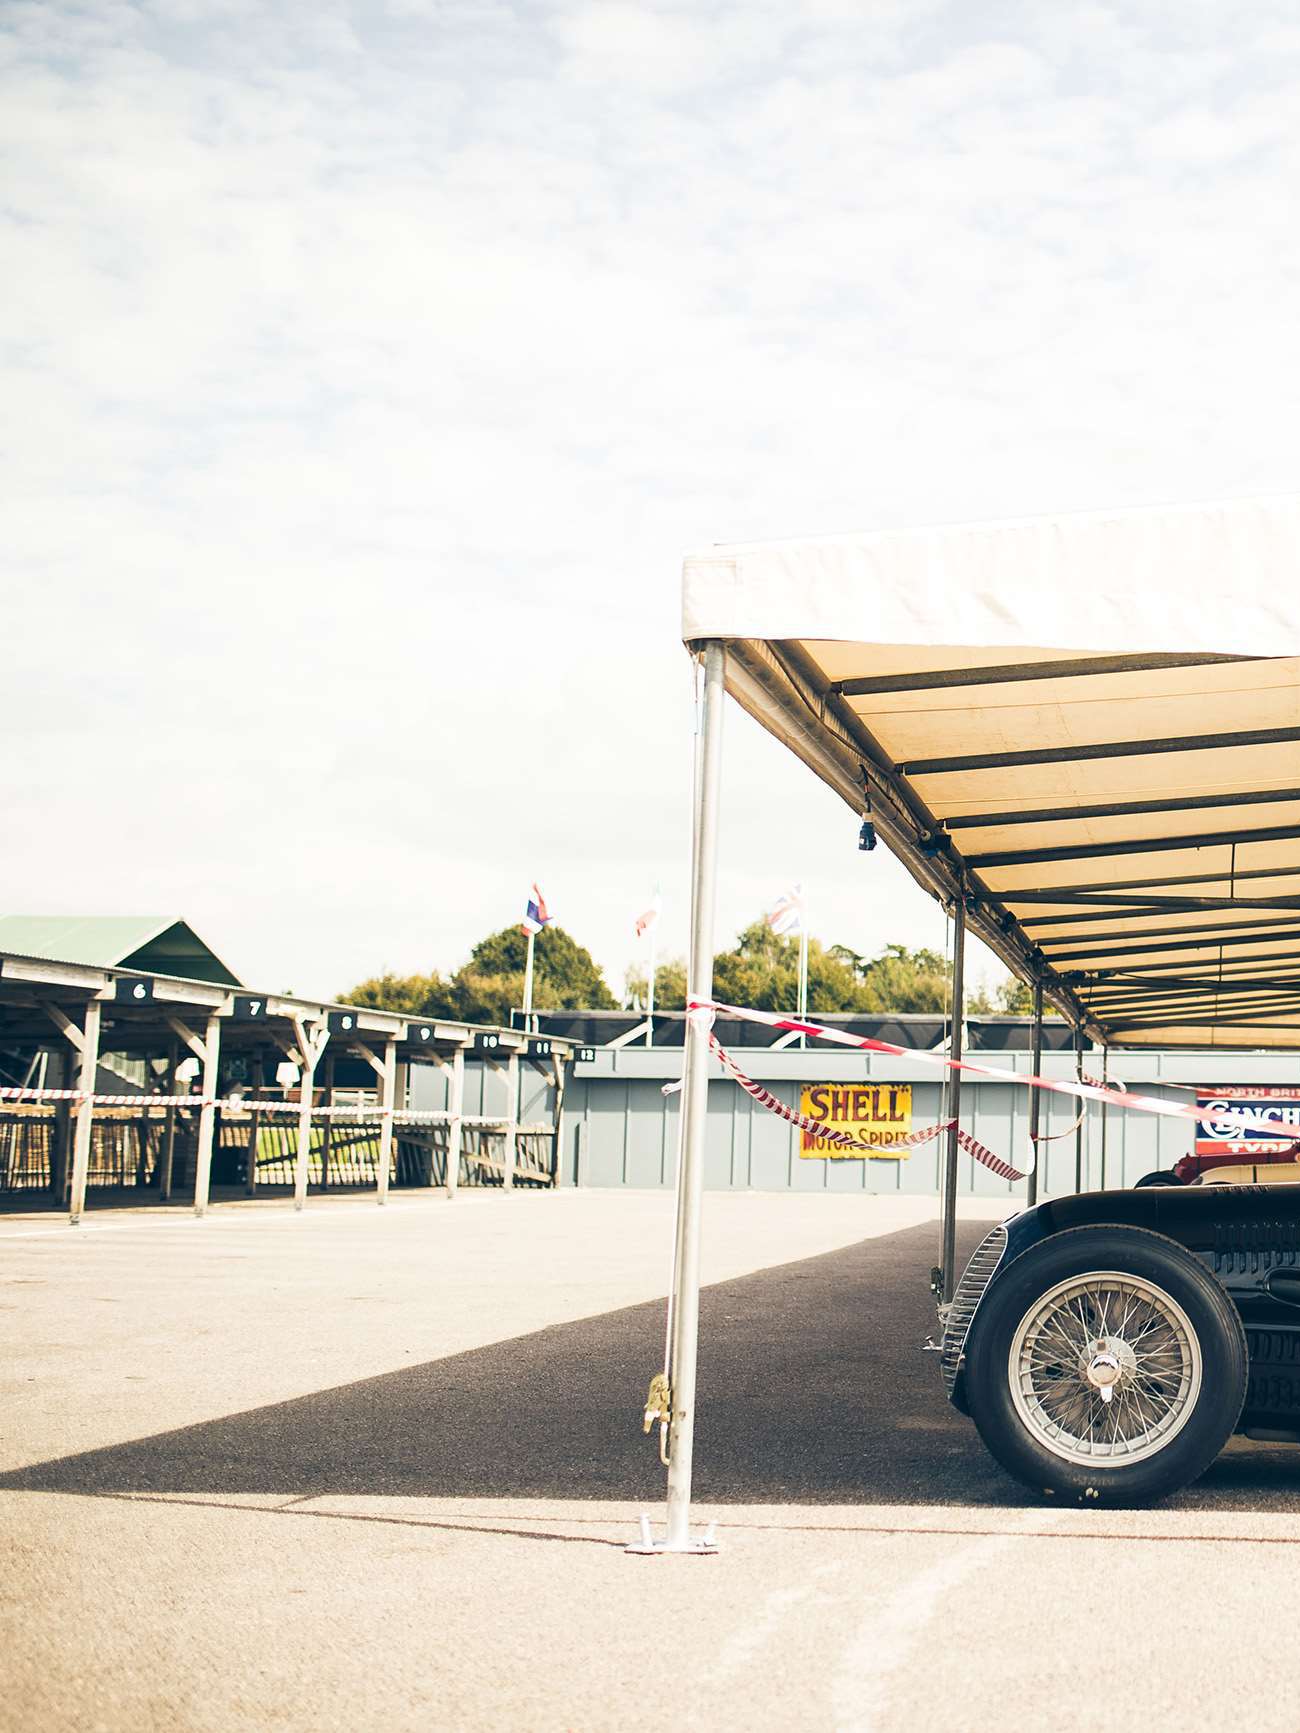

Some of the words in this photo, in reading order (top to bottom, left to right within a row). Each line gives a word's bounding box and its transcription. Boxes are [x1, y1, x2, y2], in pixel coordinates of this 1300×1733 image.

[133, 984, 147, 999] 6
[250, 1001, 261, 1016] 7
[341, 1016, 353, 1030] 8
[420, 1027, 431, 1041] 9
[482, 1035, 499, 1049] 10
[536, 1041, 550, 1055] 11
[581, 1049, 595, 1062] 12
[1215, 1087, 1265, 1097] NORTH
